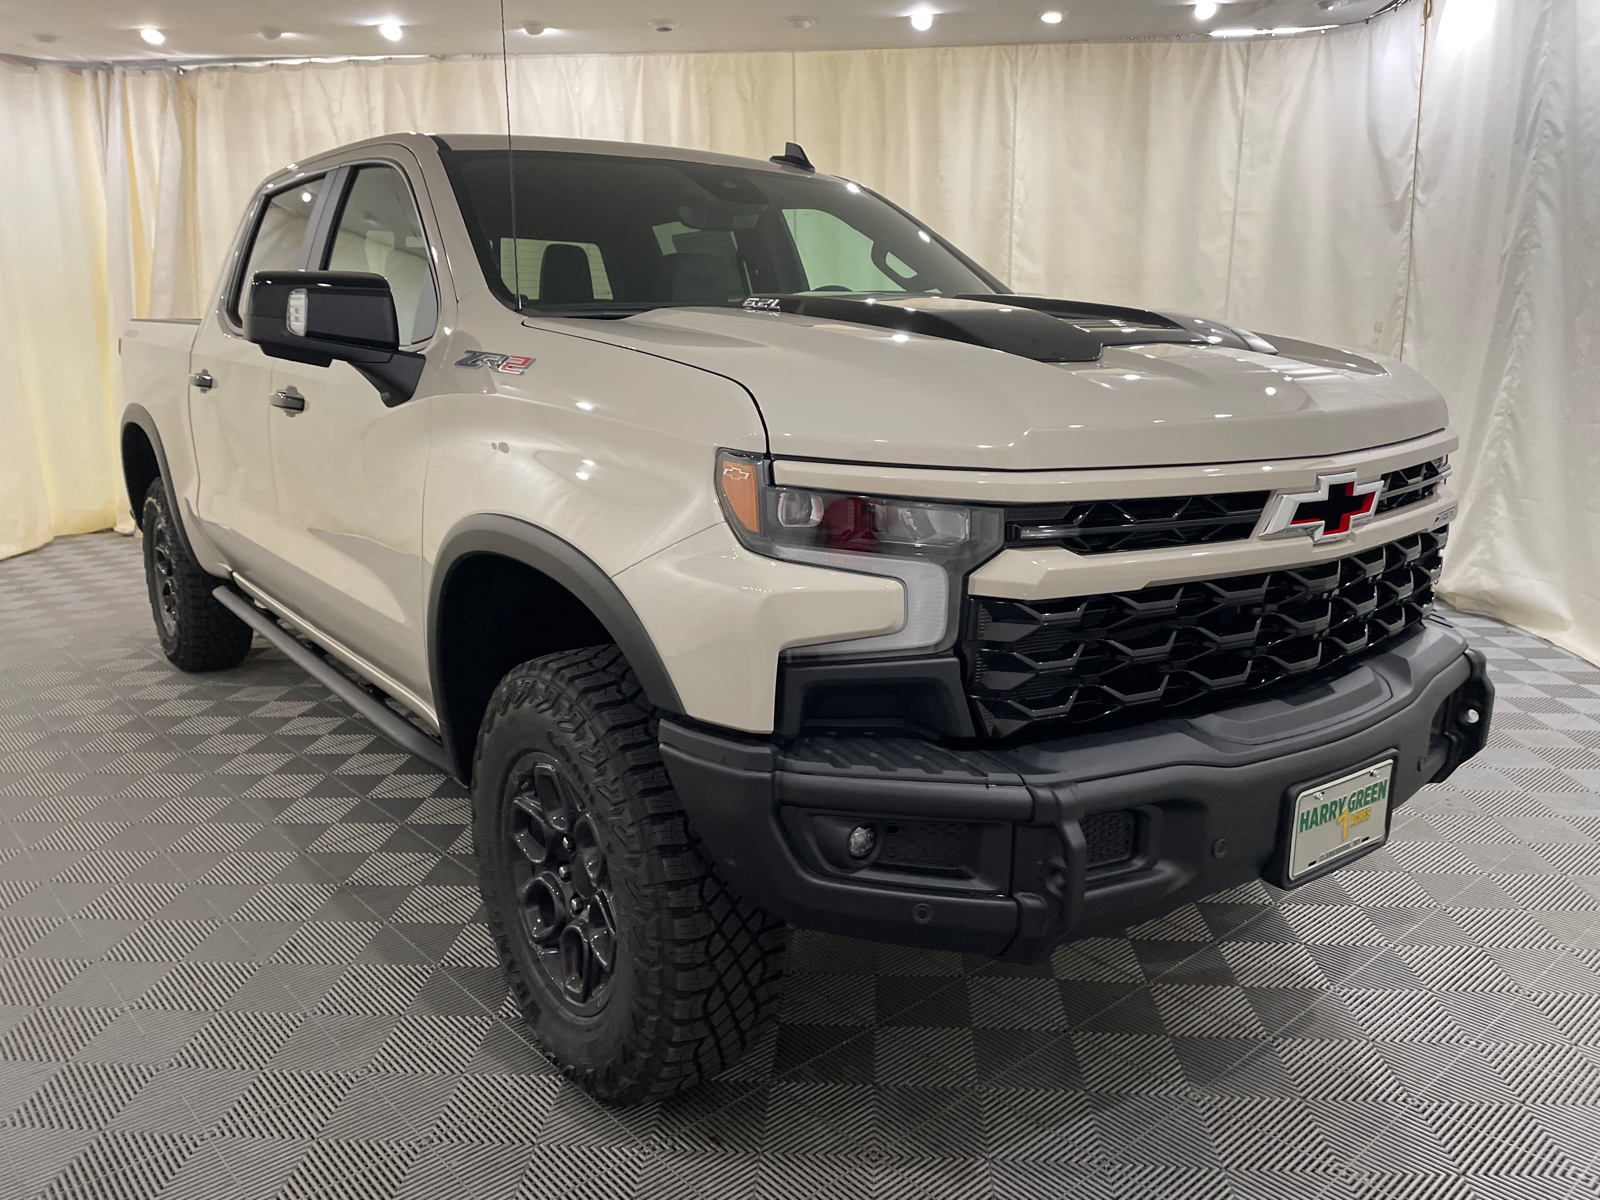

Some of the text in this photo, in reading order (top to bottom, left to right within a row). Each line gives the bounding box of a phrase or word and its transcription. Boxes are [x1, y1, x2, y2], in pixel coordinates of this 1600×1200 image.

[455, 350, 536, 375] ZR2
[1299, 779, 1388, 833] HARRY GREEN
